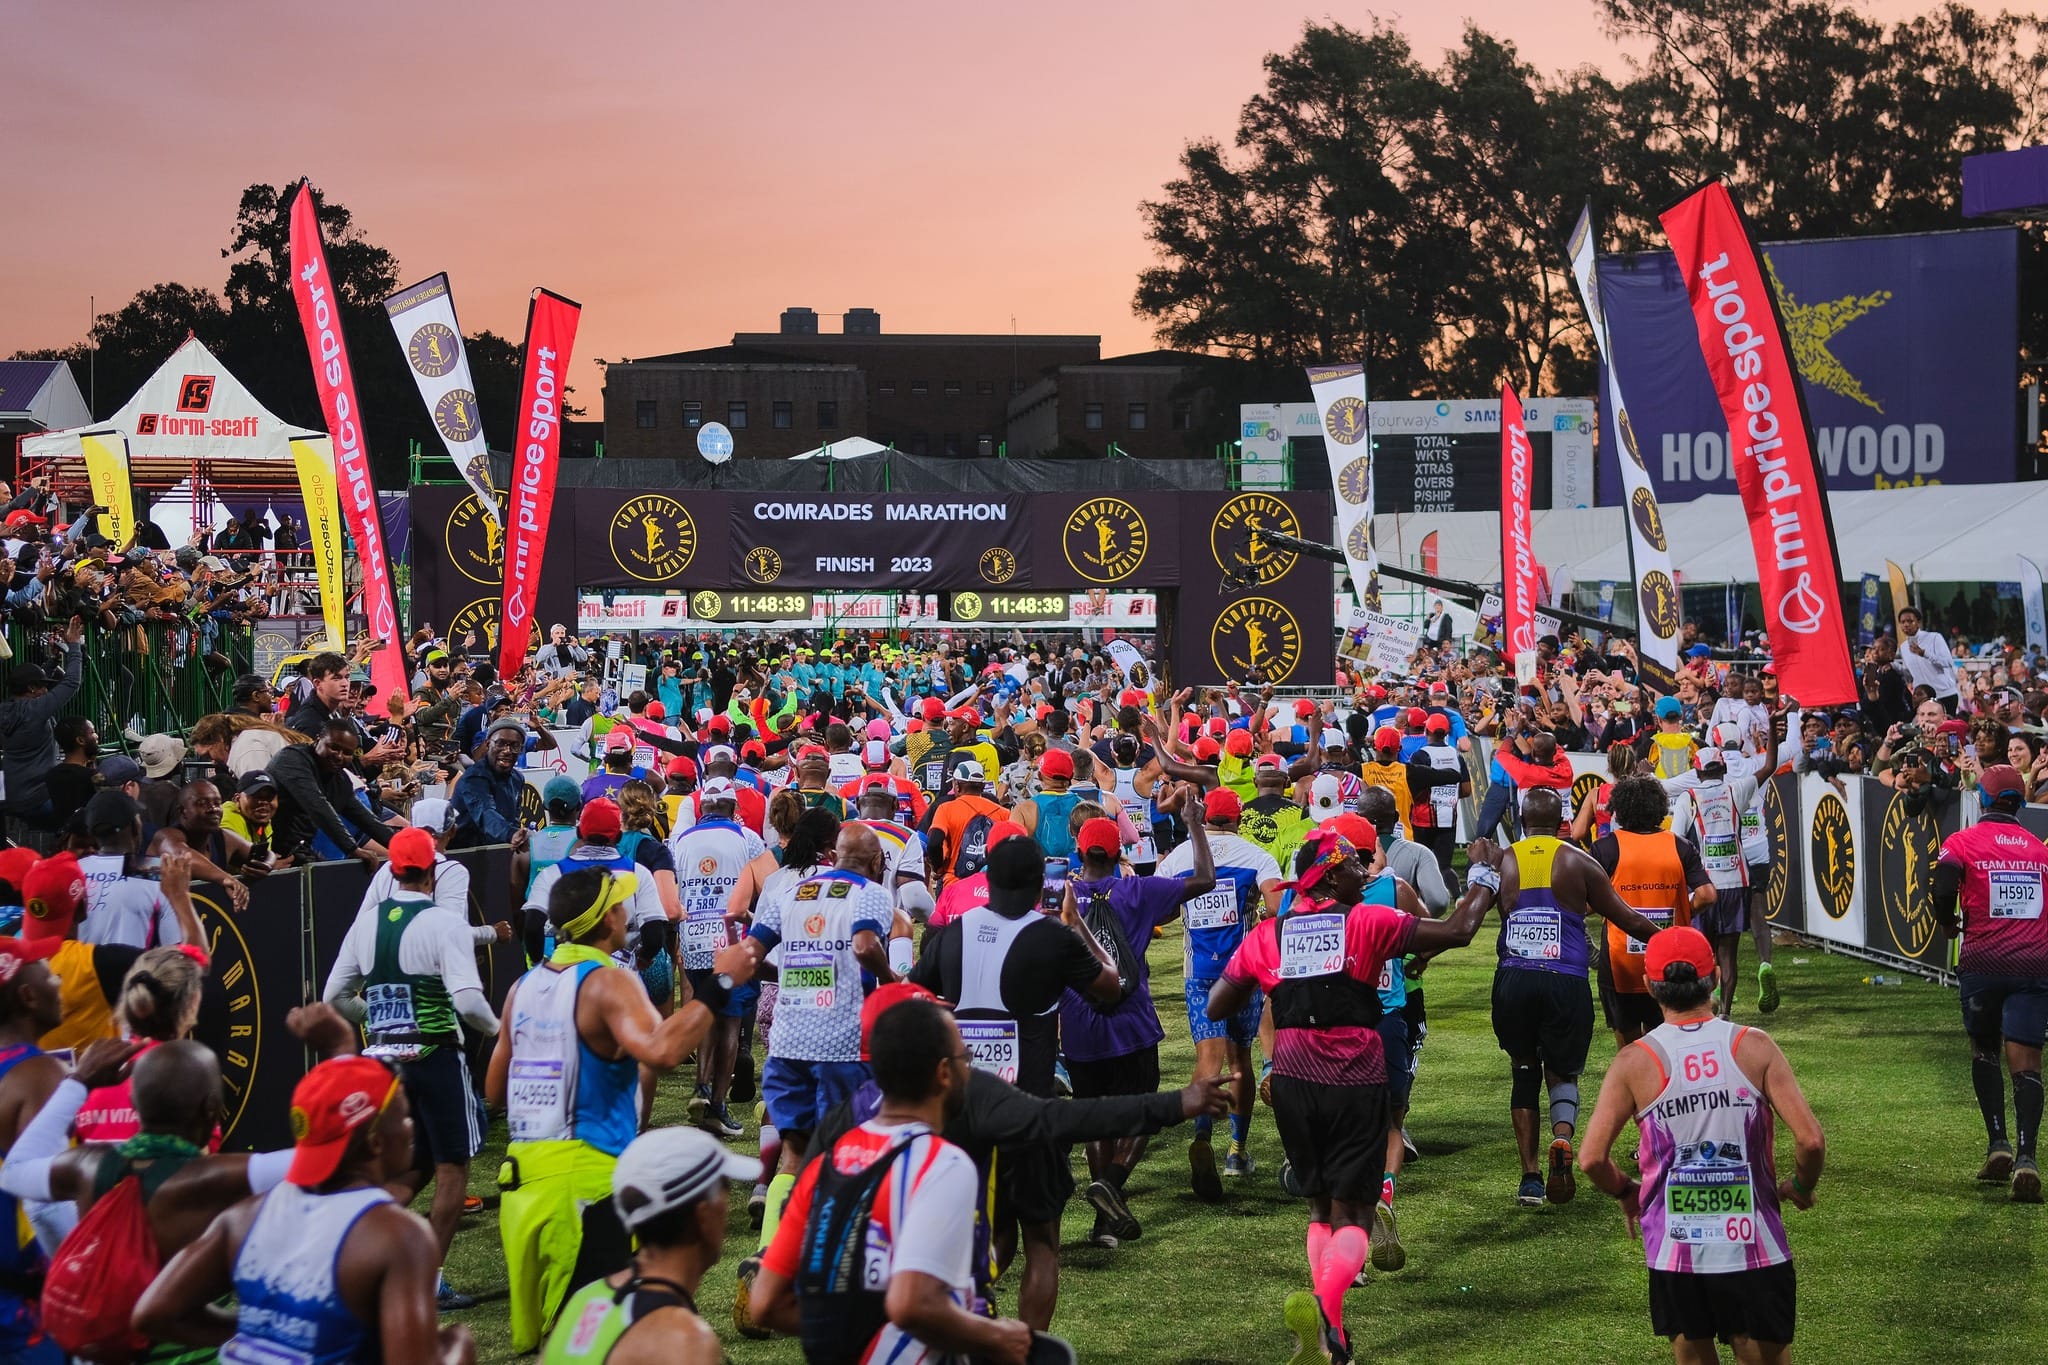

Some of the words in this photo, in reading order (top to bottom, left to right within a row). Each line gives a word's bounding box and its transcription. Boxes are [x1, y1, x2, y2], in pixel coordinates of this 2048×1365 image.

[301, 257, 342, 387] sport
[1698, 252, 1765, 381] sport
[530, 346, 557, 441] sport
[1296, 412, 1321, 425] Alli
[1372, 412, 1439, 431] fourways
[1464, 409, 1539, 423] SAMNG
[161, 415, 259, 437] form-scaff
[1414, 436, 1452, 448] TOTAL
[1743, 382, 1801, 503] price
[335, 392, 371, 512] price
[1415, 450, 1449, 461] WKTS
[1662, 422, 1945, 482] HOLWOOD
[1415, 463, 1454, 475] XTRAS
[1508, 424, 1526, 499] sport
[518, 443, 545, 532] price
[1414, 477, 1454, 489] OVERS
[1414, 490, 1451, 501] P/SHIP
[754, 503, 873, 521] COMRADES
[886, 503, 1006, 521] MARATHON
[362, 516, 384, 580] mr
[1510, 502, 1533, 578] price
[1769, 508, 1808, 571] mr
[514, 533, 529, 581] mr
[816, 557, 875, 572] FINISH
[891, 557, 932, 572] 2023
[1486, 596, 1499, 607] GO
[1515, 572, 1531, 619] mr
[731, 596, 805, 614] 11:48:39
[990, 597, 1063, 614] 11:48:39
[1353, 609, 1366, 619] GO
[1368, 613, 1395, 628] DADDY
[1396, 622, 1410, 632] GO
[1748, 826, 1759, 836] 50
[1994, 834, 2029, 848] Vitality
[1975, 860, 2006, 872] TEAM
[86, 871, 129, 883] HOSA
[1620, 884, 1637, 892] RCS
[1642, 883, 1666, 891] GUGS
[2000, 884, 2036, 900] H5912
[1221, 910, 1238, 925] 40
[687, 921, 725, 937] C29750
[1511, 926, 1557, 941] H46755
[712, 935, 727, 949] 50
[783, 940, 852, 952] IEPKLOOF
[977, 935, 998, 944] CLUB
[1286, 933, 1340, 955] H47253
[1543, 945, 1559, 958] 40
[1323, 954, 1342, 972] 40
[785, 969, 831, 989] E38285
[816, 989, 833, 1008] 60
[1683, 1050, 1720, 1082] 65
[1657, 1089, 1731, 1121] KEMPTON
[1678, 1171, 1735, 1183] HOLLYWOOD
[1671, 1188, 1747, 1213] E45894
[1726, 1216, 1752, 1241] 60
